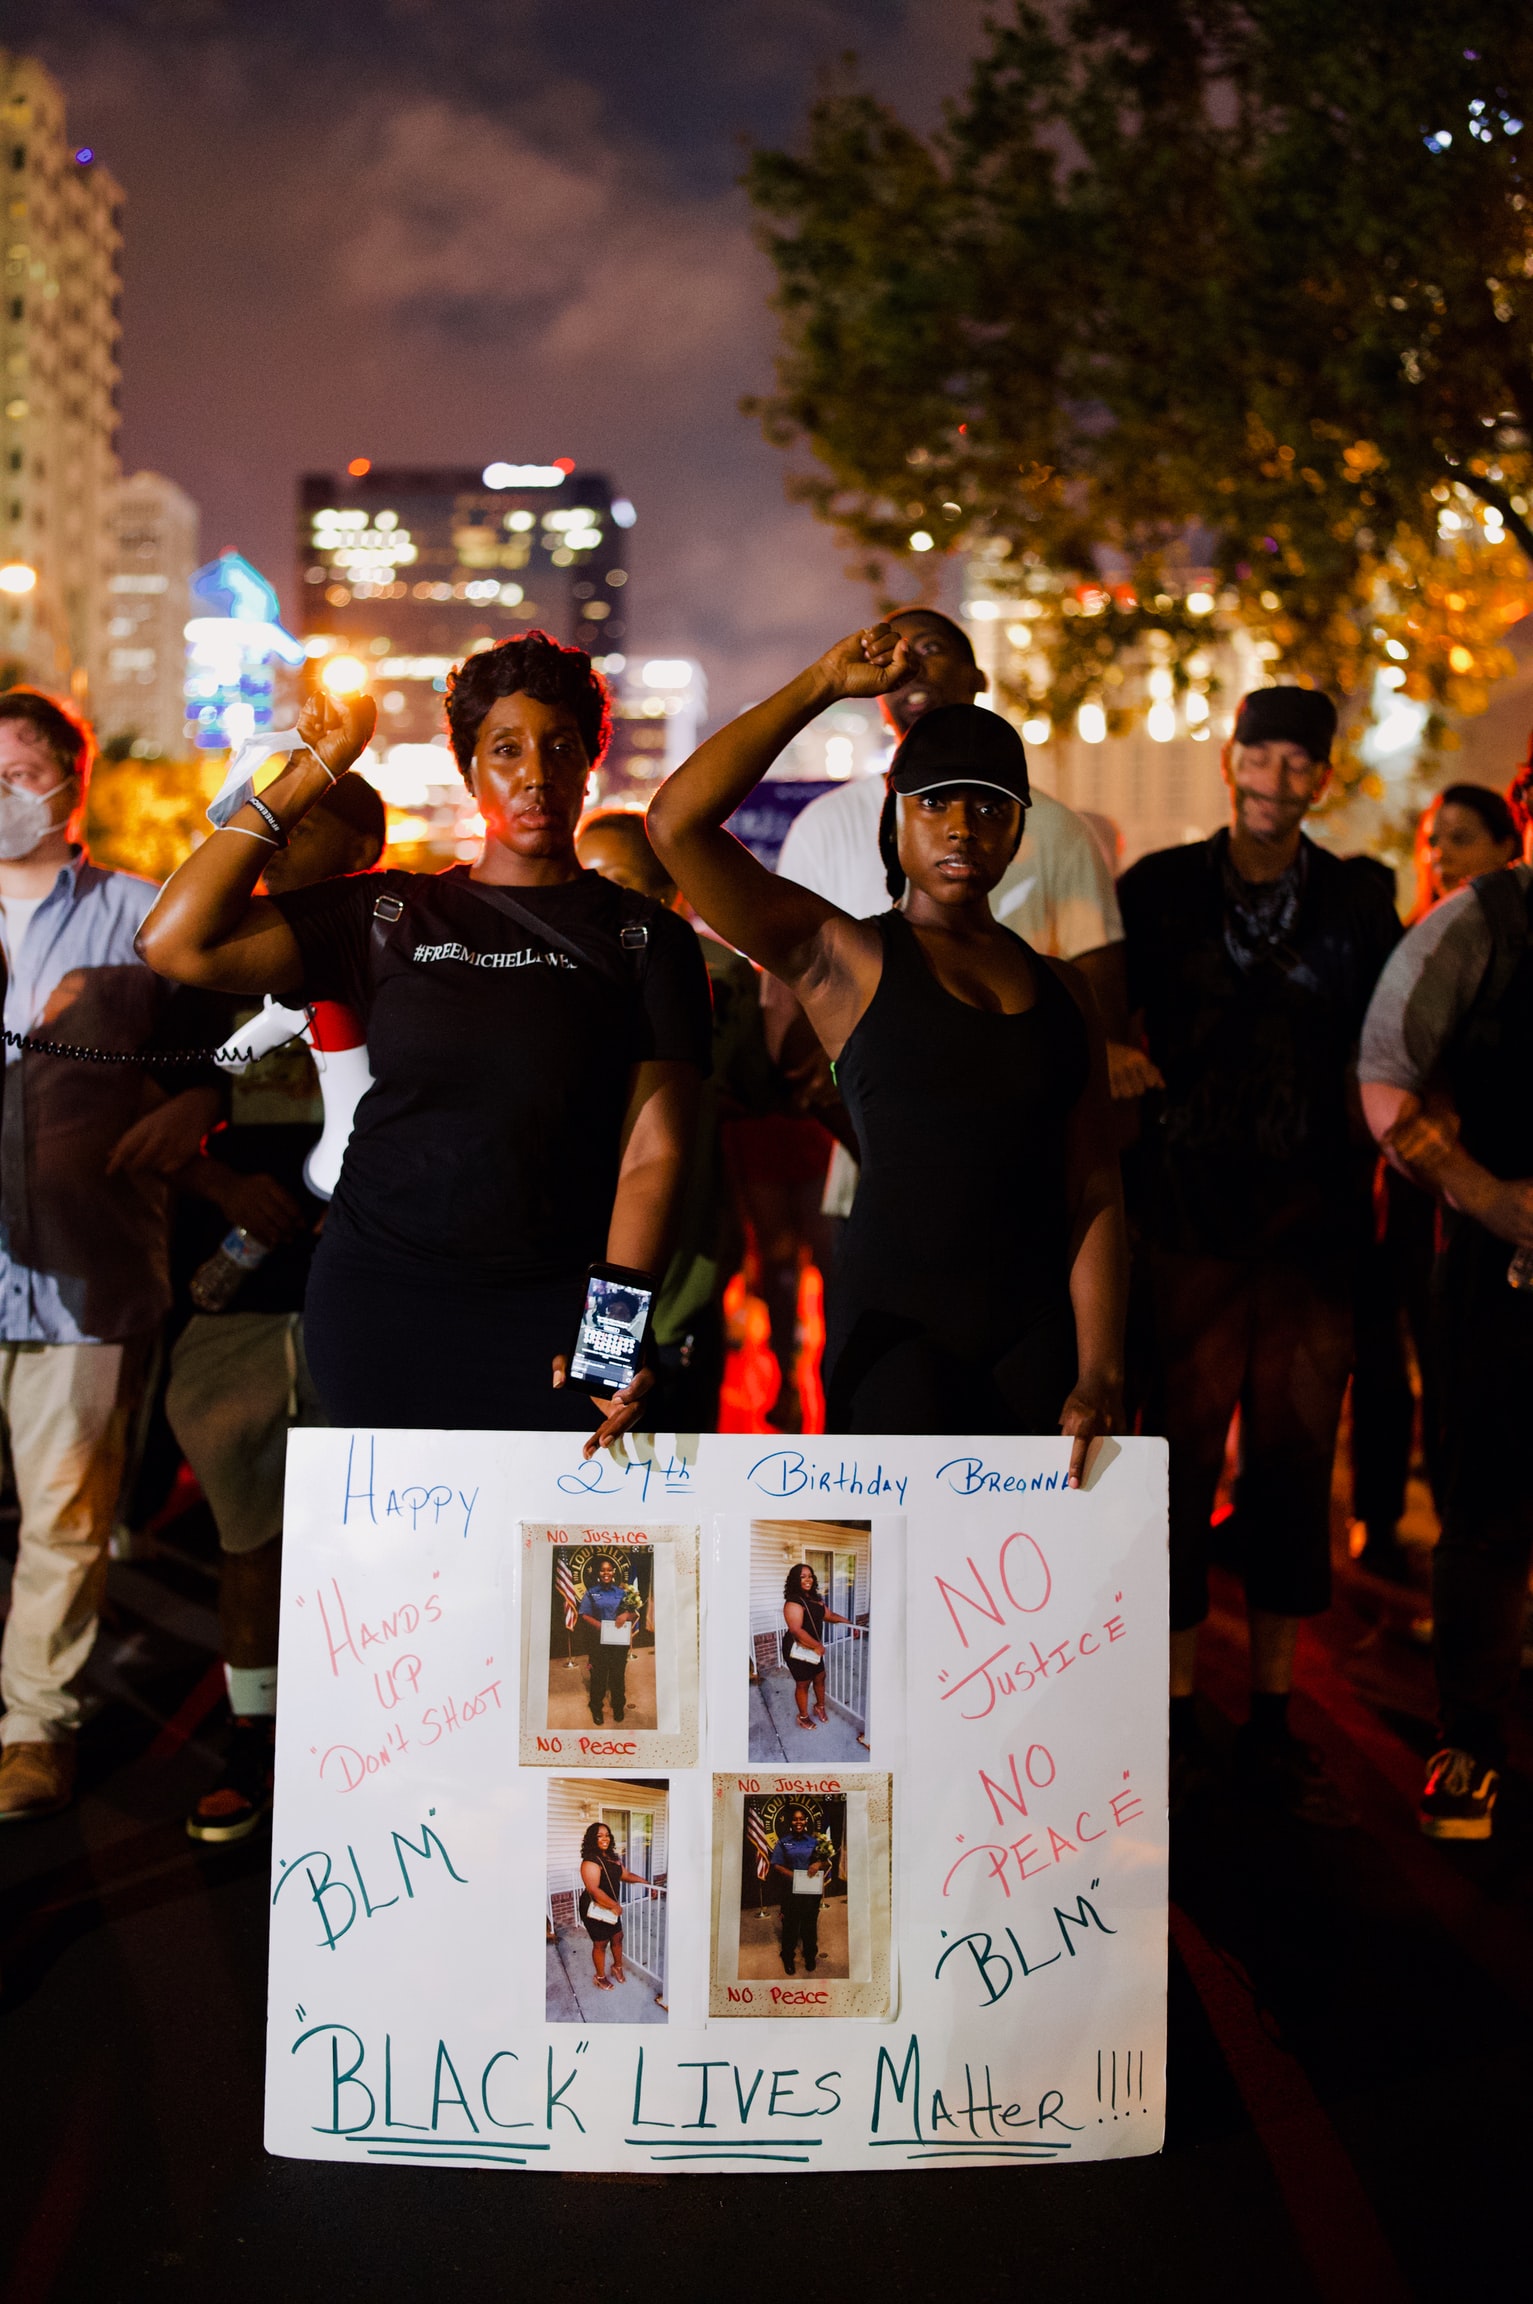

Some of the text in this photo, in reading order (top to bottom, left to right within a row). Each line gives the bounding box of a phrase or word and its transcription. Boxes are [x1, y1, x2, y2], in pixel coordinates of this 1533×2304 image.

[412, 942, 578, 969] #FREEMICHELLWE
[546, 1529, 569, 1543] NO
[934, 1532, 1052, 1648] NO
[373, 1653, 423, 1710] UP
[535, 1736, 563, 1753] NO
[738, 1778, 761, 1793] NO
[979, 1743, 1056, 1826] NO
[727, 1986, 754, 2004] NO
[632, 2045, 842, 2129] LIVES
